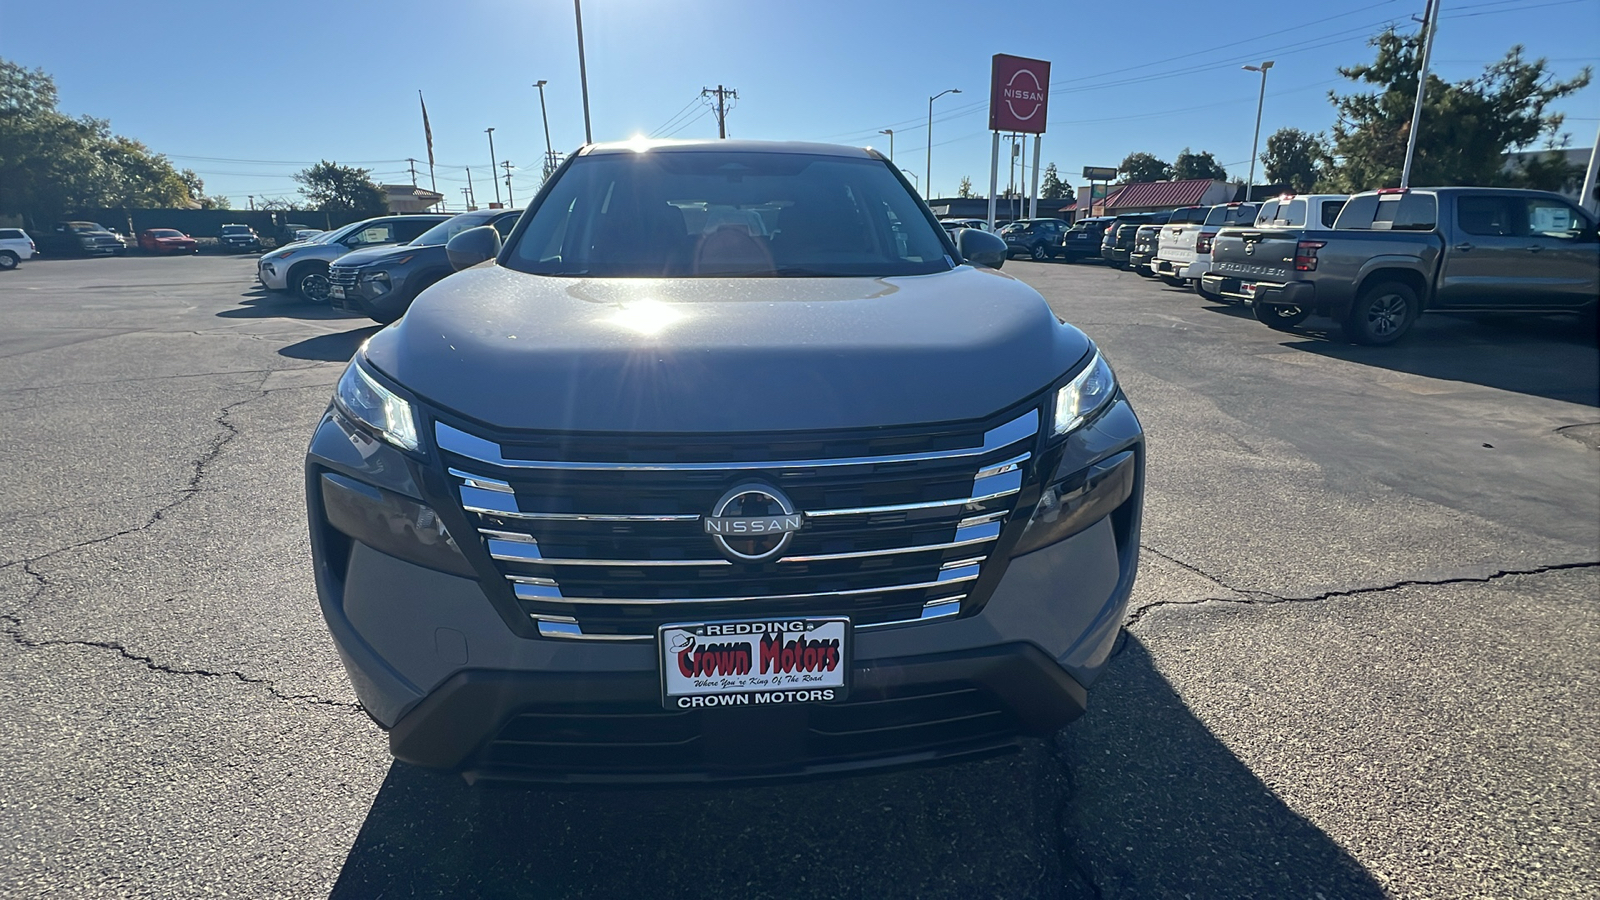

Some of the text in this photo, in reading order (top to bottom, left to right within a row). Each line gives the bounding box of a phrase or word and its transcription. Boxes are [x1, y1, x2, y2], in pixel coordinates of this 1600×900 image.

[1004, 88, 1044, 101] NISSAN
[1219, 263, 1286, 277] FRONTIER
[706, 517, 799, 532] NISSAN
[706, 621, 804, 635] REDDING
[678, 633, 840, 678] Crown Motors
[694, 674, 823, 689] Where You're King Of The Road
[678, 689, 835, 708] CROWN MOTORS
